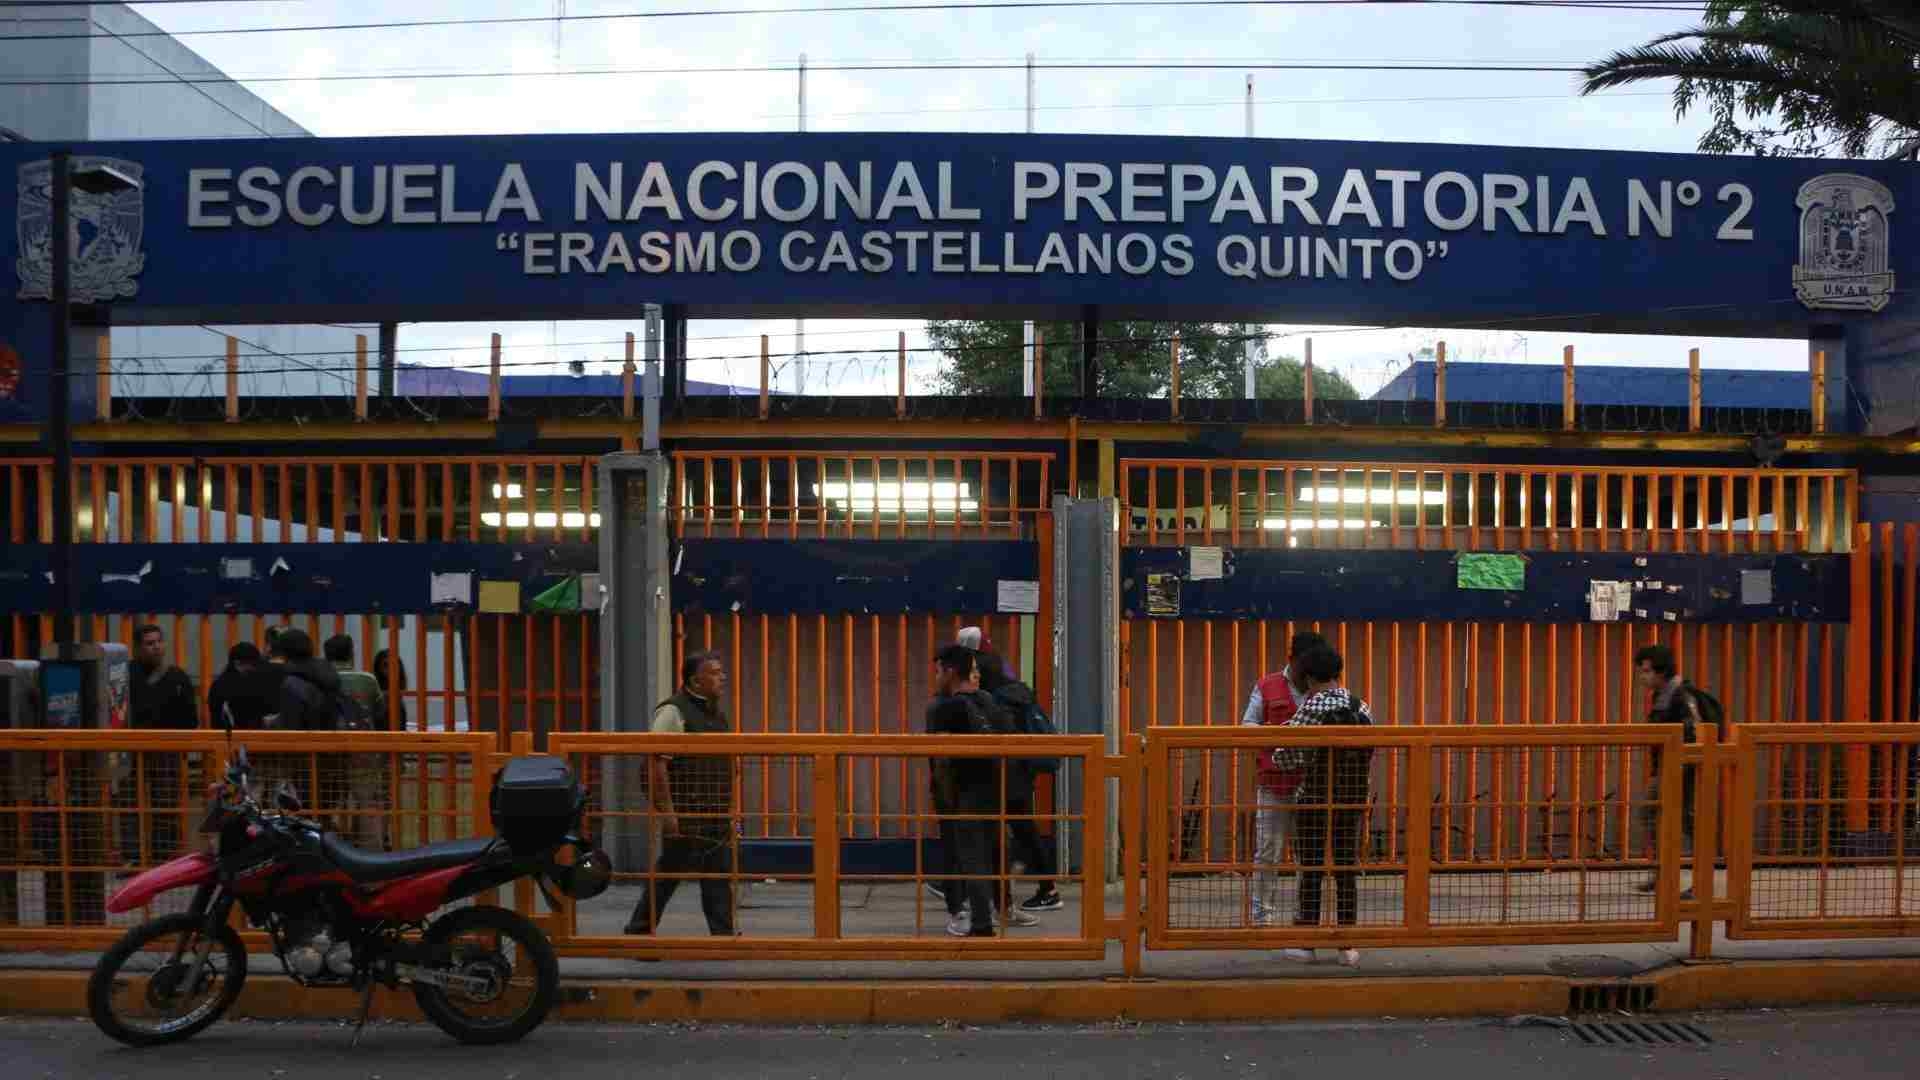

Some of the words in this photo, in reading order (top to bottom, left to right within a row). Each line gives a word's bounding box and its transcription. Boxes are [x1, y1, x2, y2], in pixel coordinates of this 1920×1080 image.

[187, 162, 542, 230] ESCUELA
[573, 159, 982, 224] NACIONAL
[1012, 160, 1608, 237] PREPARATORIA
[1715, 181, 1754, 241] 2
[778, 229, 1195, 277] CASTELLANOS
